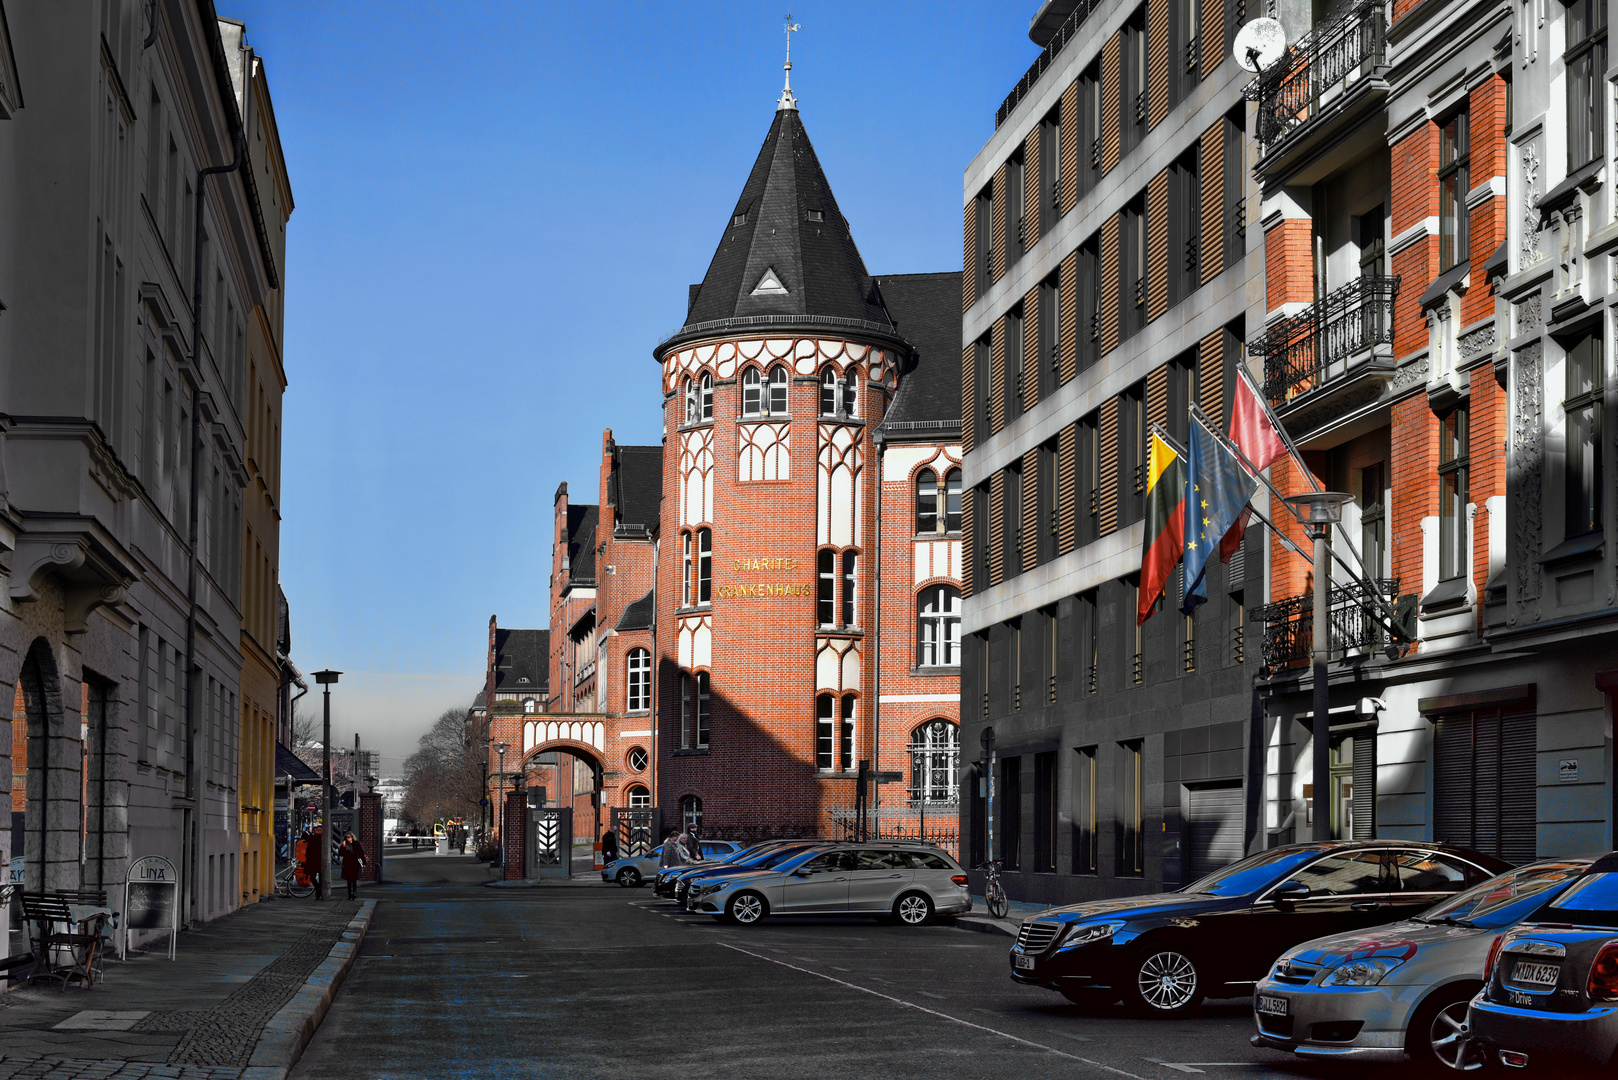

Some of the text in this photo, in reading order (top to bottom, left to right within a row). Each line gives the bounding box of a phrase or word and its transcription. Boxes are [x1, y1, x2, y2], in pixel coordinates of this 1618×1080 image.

[717, 584, 811, 598] KRANKENHAUS
[140, 866, 165, 881] LINA
[1536, 966, 1558, 983] 6239
